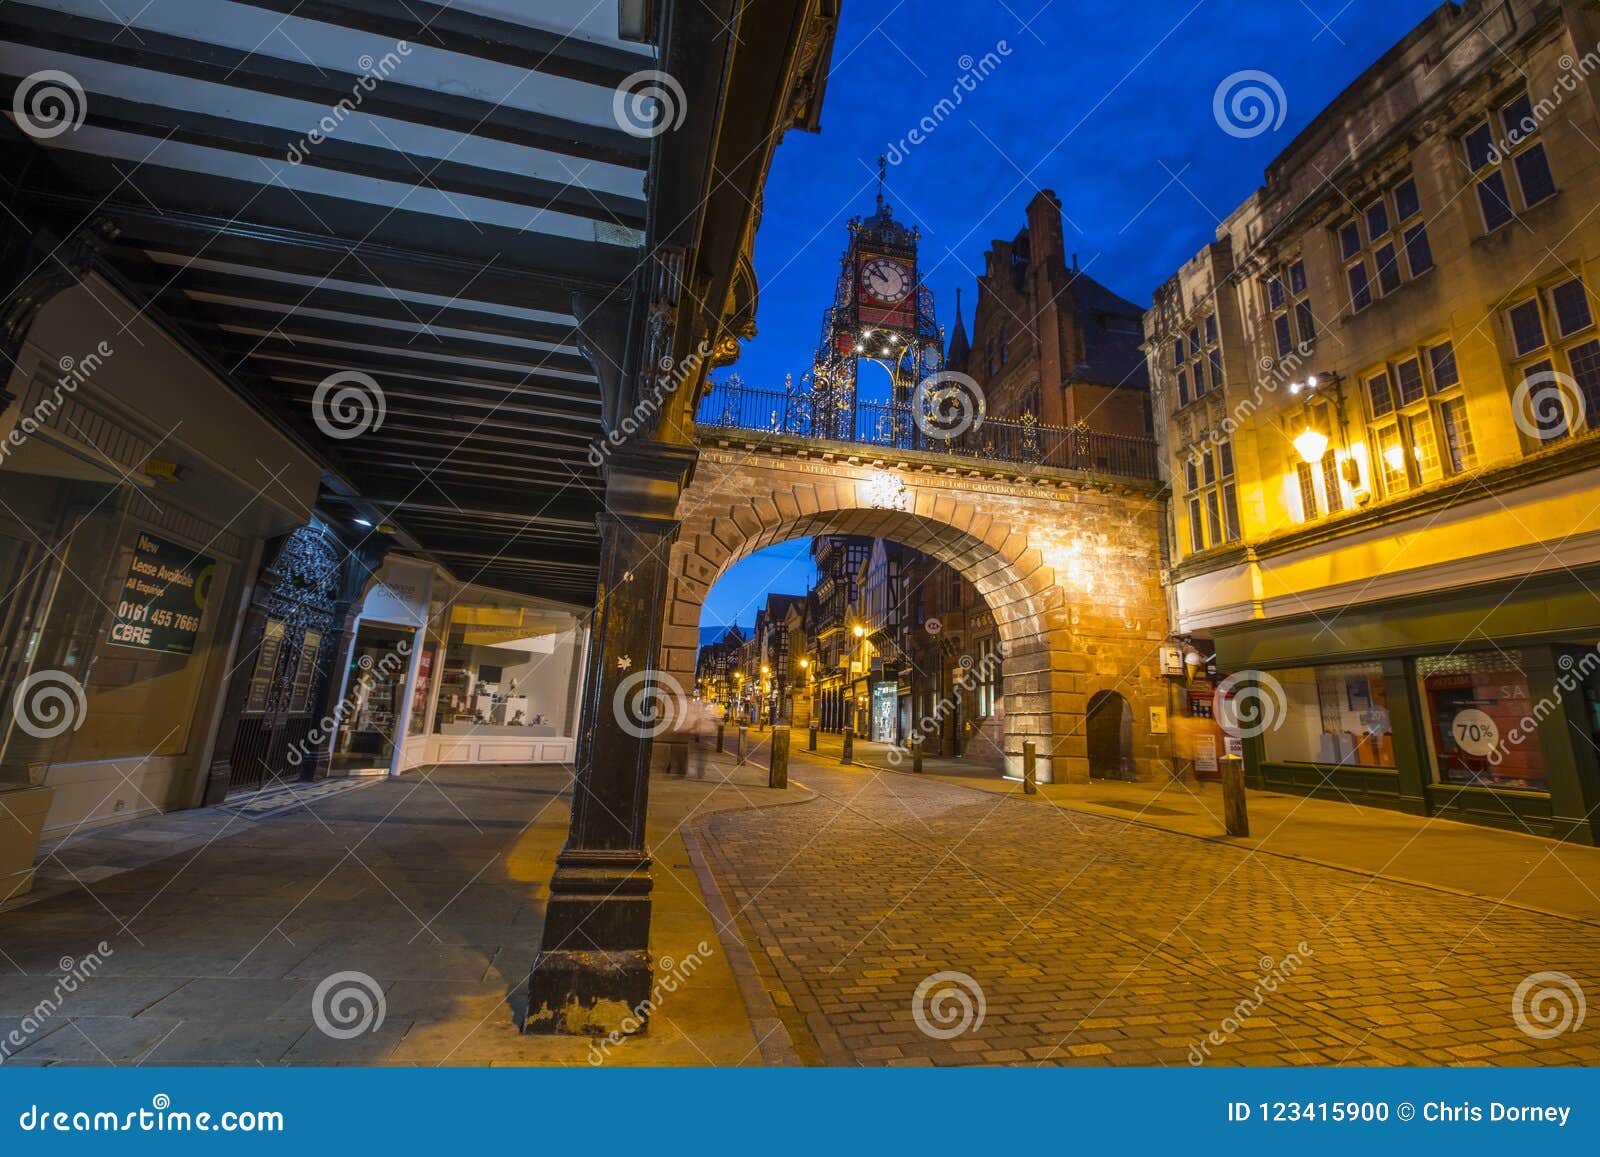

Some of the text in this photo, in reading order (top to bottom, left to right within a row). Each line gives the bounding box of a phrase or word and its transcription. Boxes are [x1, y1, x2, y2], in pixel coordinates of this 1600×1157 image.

[138, 534, 160, 554] New
[131, 556, 158, 577] Lease
[117, 600, 149, 622] 0161
[151, 608, 174, 628] 455
[111, 623, 153, 645] CBRE
[1456, 723, 1494, 742] 70%
